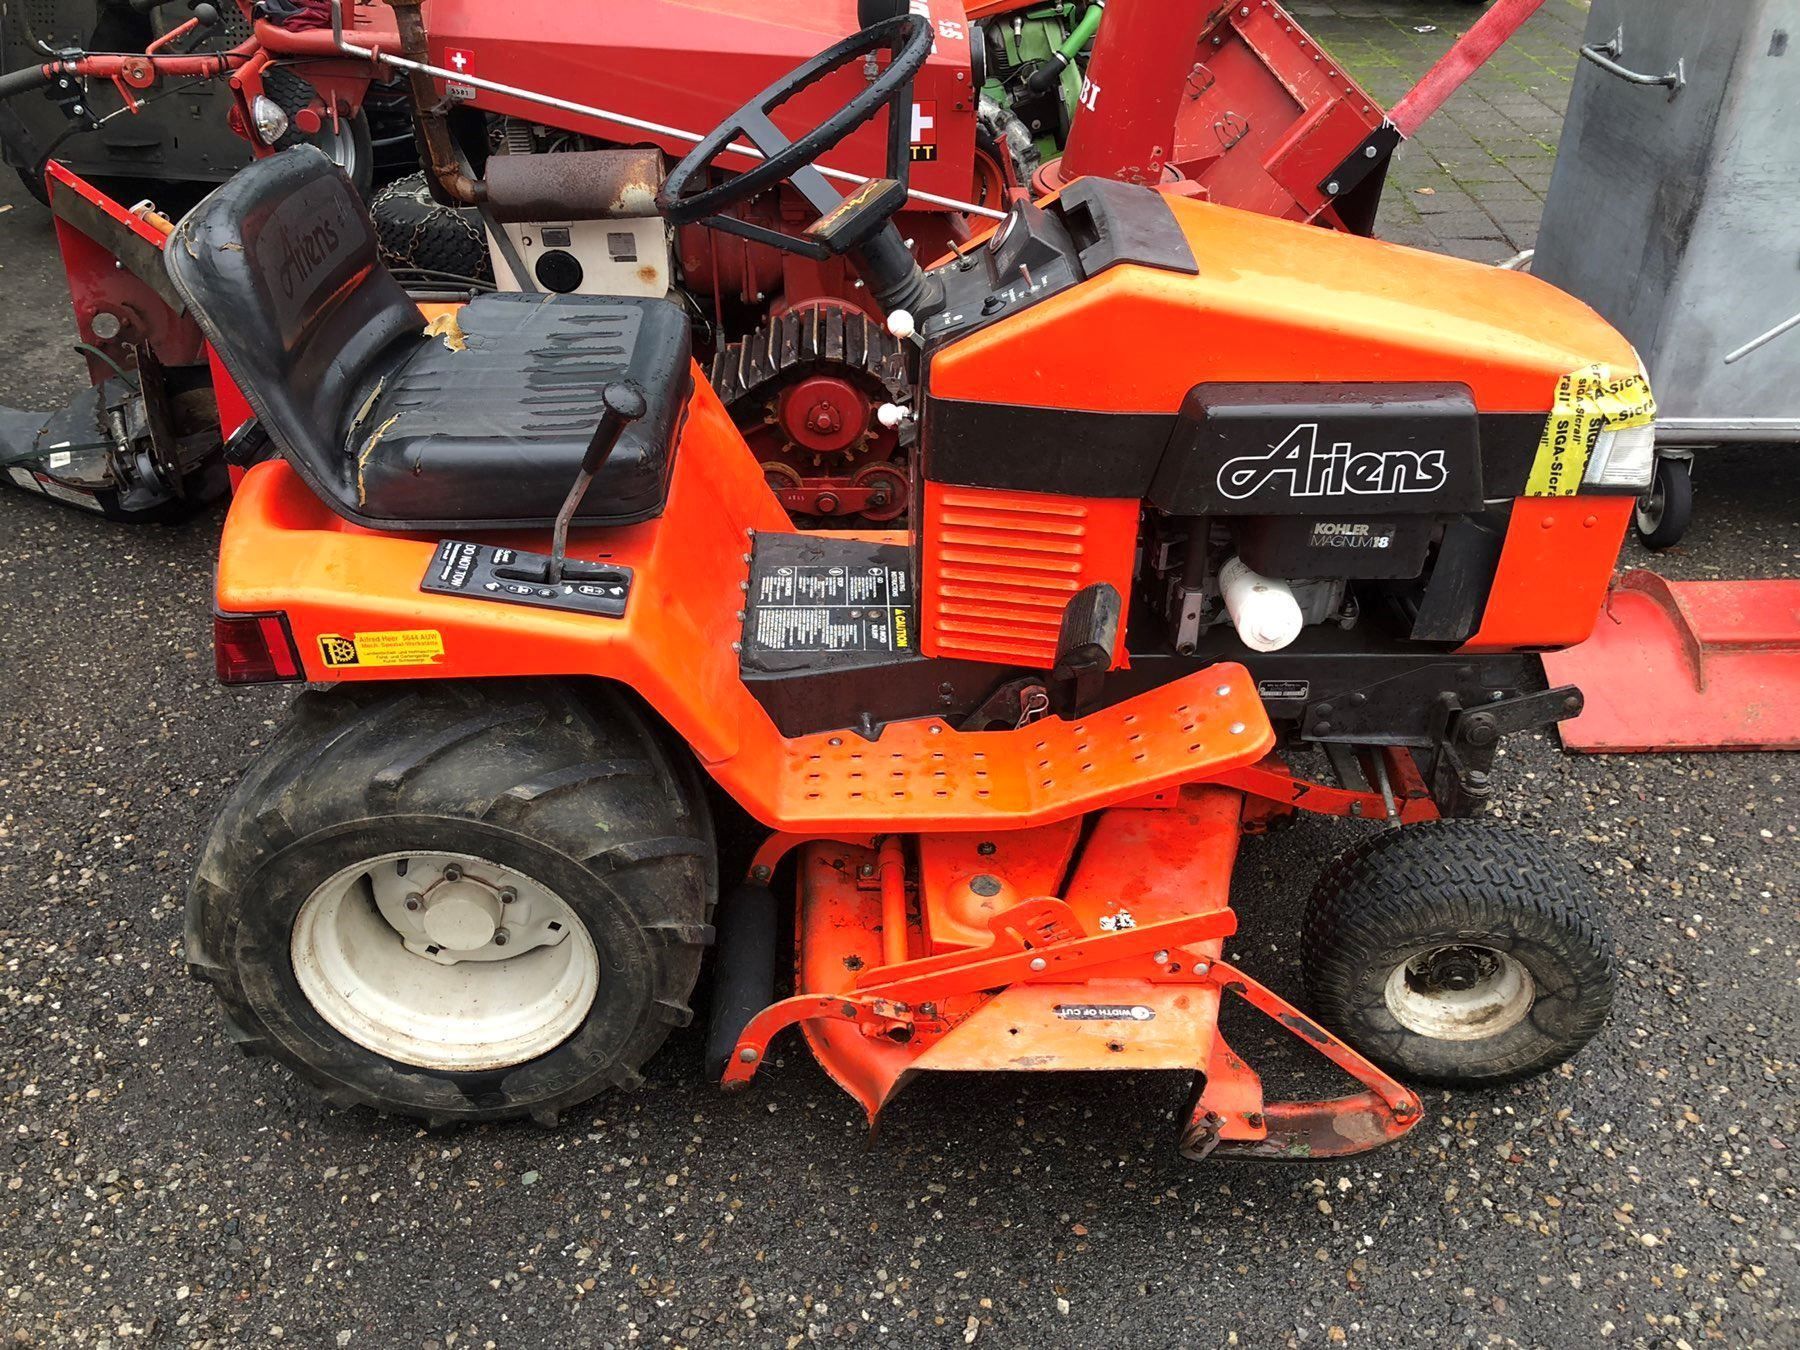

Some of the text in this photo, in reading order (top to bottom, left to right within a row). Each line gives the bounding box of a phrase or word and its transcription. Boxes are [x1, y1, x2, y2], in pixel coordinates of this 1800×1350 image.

[1216, 423, 1448, 499] Ariens
[1313, 522, 1370, 536] KOHLER
[450, 544, 476, 587] DO NOT TOW
[895, 615, 908, 648] CAUTION
[1062, 1008, 1131, 1016] WIDTH OF CUT
